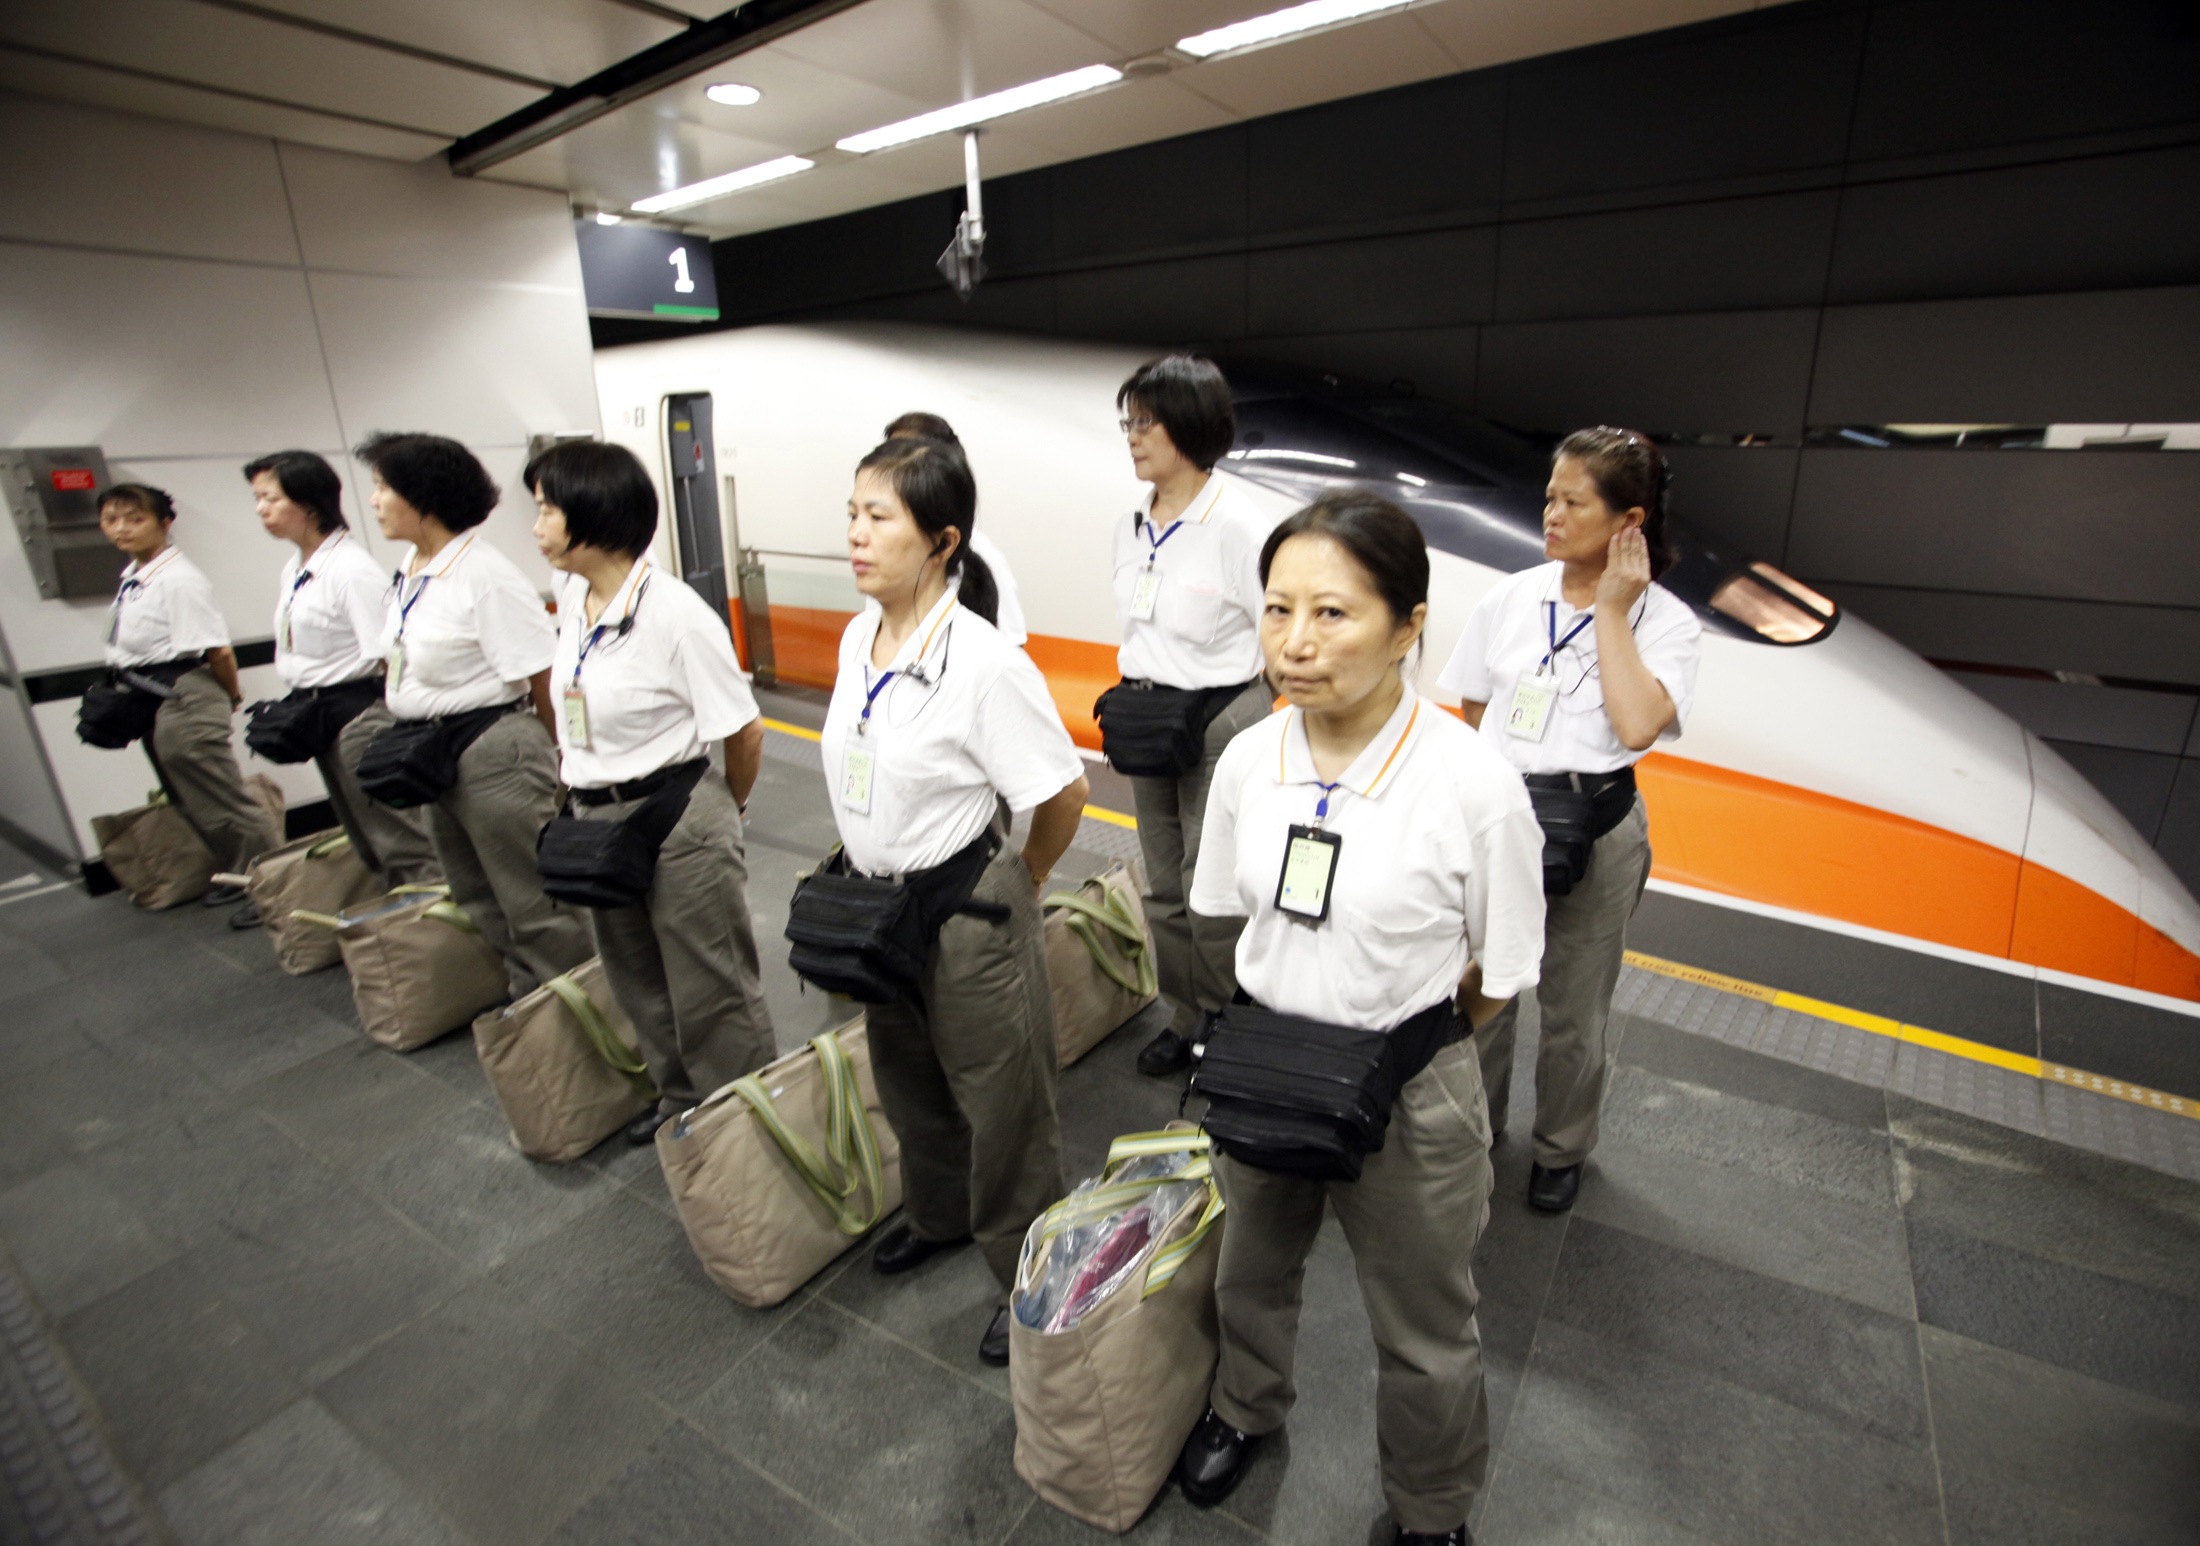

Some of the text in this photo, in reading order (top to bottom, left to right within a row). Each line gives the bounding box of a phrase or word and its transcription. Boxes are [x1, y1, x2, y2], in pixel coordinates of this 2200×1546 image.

[668, 246, 695, 293] 1
[1681, 970, 1729, 988] yellow
[1733, 982, 1763, 997] line
